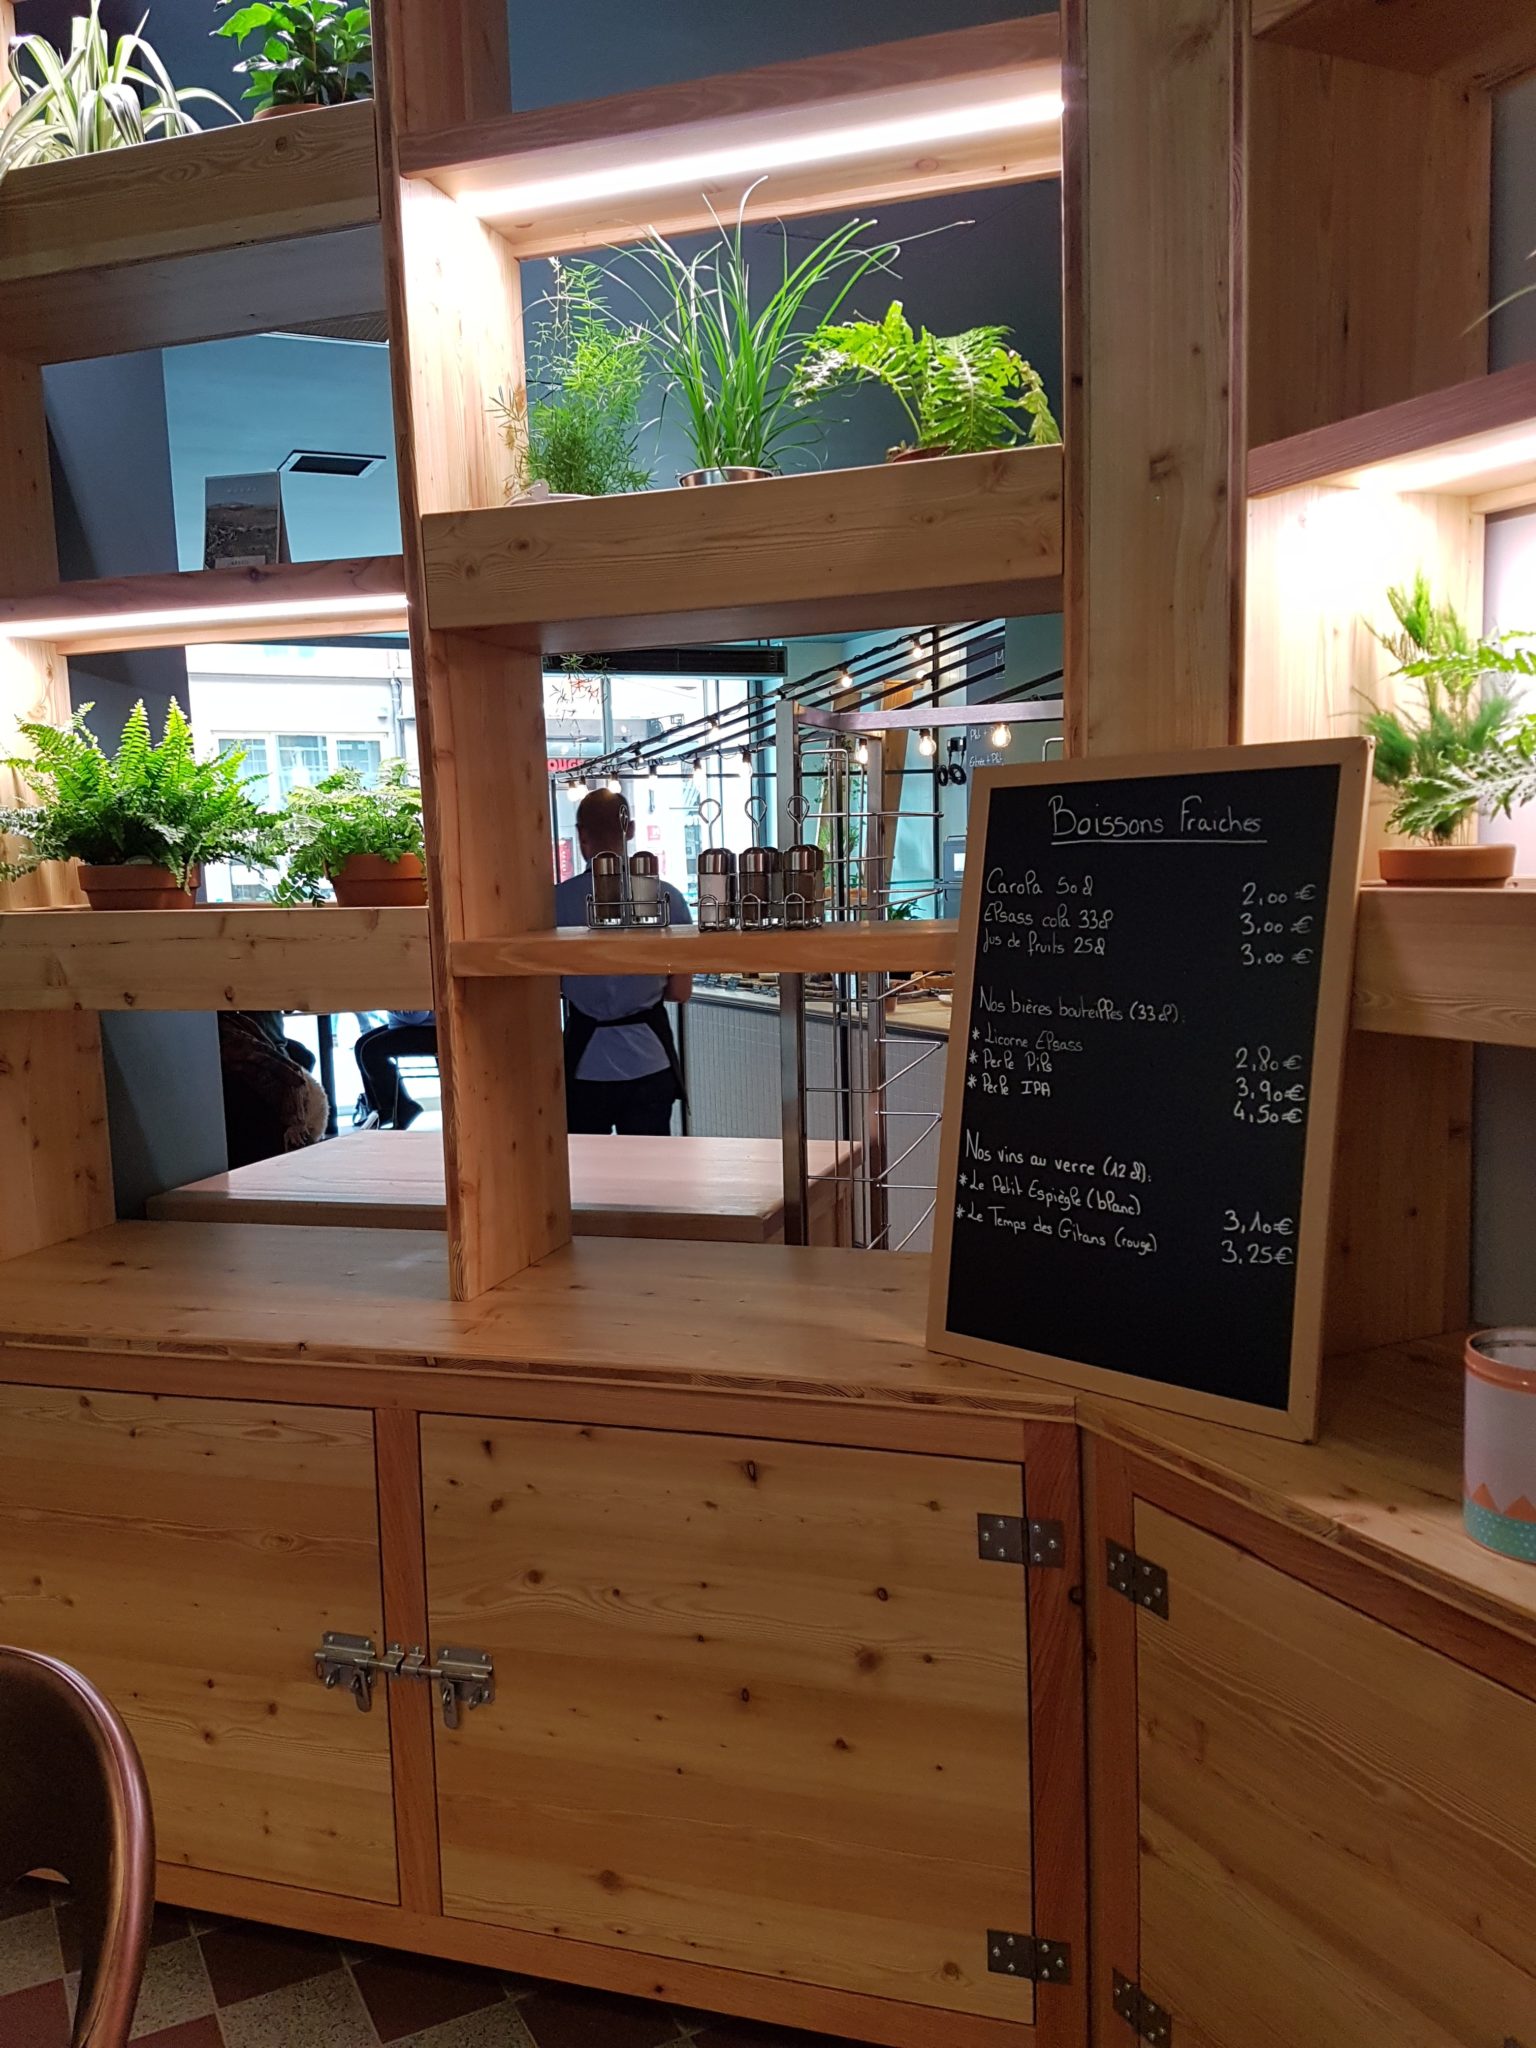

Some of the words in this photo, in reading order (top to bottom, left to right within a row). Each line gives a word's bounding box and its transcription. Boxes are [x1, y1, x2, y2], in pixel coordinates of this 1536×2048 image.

[1048, 795, 1164, 837] Boissons
[986, 867, 1043, 895] Carola
[984, 901, 1034, 925] Elsass
[1042, 903, 1071, 928] cola
[1007, 931, 1020, 948] de
[1028, 930, 1065, 957] fruits
[979, 985, 1006, 1013] Nos
[1010, 989, 1052, 1016] bières
[1058, 995, 1123, 1021] bouteilles
[984, 1022, 1028, 1048] Licorne
[1035, 1030, 1084, 1052] Elsass
[982, 1048, 1016, 1071] Perle
[1024, 1051, 1053, 1073] Pils
[981, 1072, 1009, 1096] Perle
[1020, 1080, 1051, 1097] IPA
[965, 1128, 993, 1162] Nos
[998, 1146, 1025, 1165] vins
[1030, 1154, 1047, 1167] au
[1054, 1158, 1096, 1176] verre
[991, 1174, 1024, 1197] Petit
[1028, 1179, 1081, 1212] Espiègle
[1085, 1187, 1141, 1216] (blanc)
[987, 1206, 1027, 1235] Temps
[1032, 1215, 1053, 1235] des
[1057, 1217, 1106, 1247] Gitans
[1113, 1226, 1158, 1256] (rouge)
